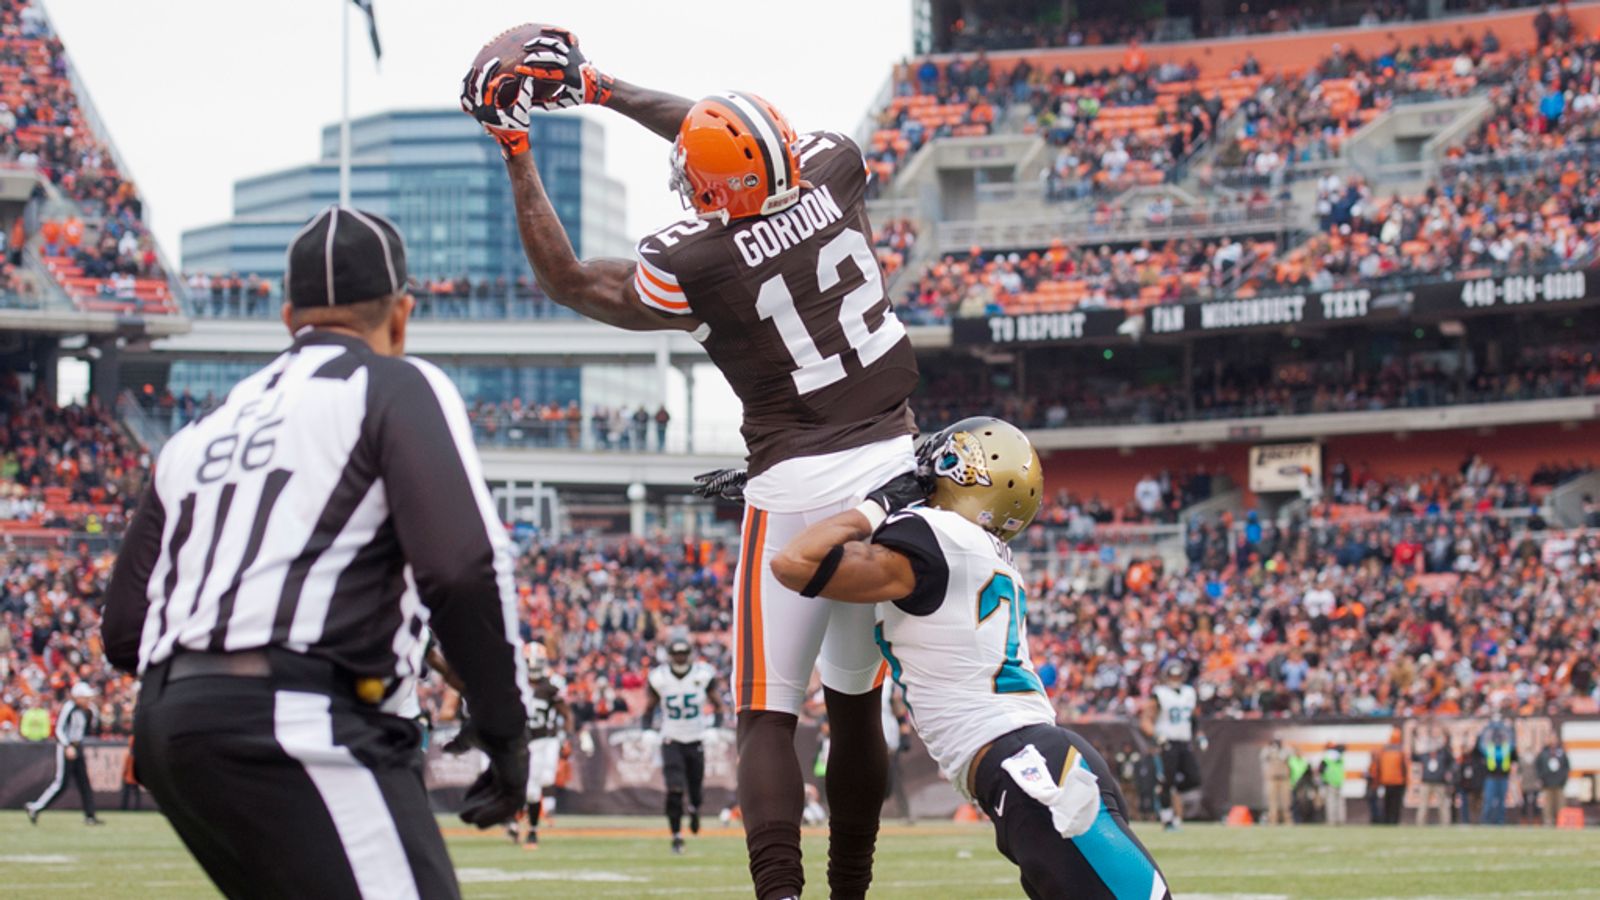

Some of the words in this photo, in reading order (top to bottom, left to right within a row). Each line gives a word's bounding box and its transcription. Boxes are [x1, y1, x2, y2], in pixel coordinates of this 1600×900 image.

[734, 184, 843, 268] GORDON
[755, 227, 906, 395] 12
[989, 316, 1014, 342] TO
[1017, 312, 1087, 341] REPORT
[1152, 305, 1184, 333] FAN
[1201, 296, 1306, 328] MISCONDUCT
[1321, 289, 1371, 319] TEXT
[196, 417, 285, 484] 86
[666, 694, 699, 719] 55
